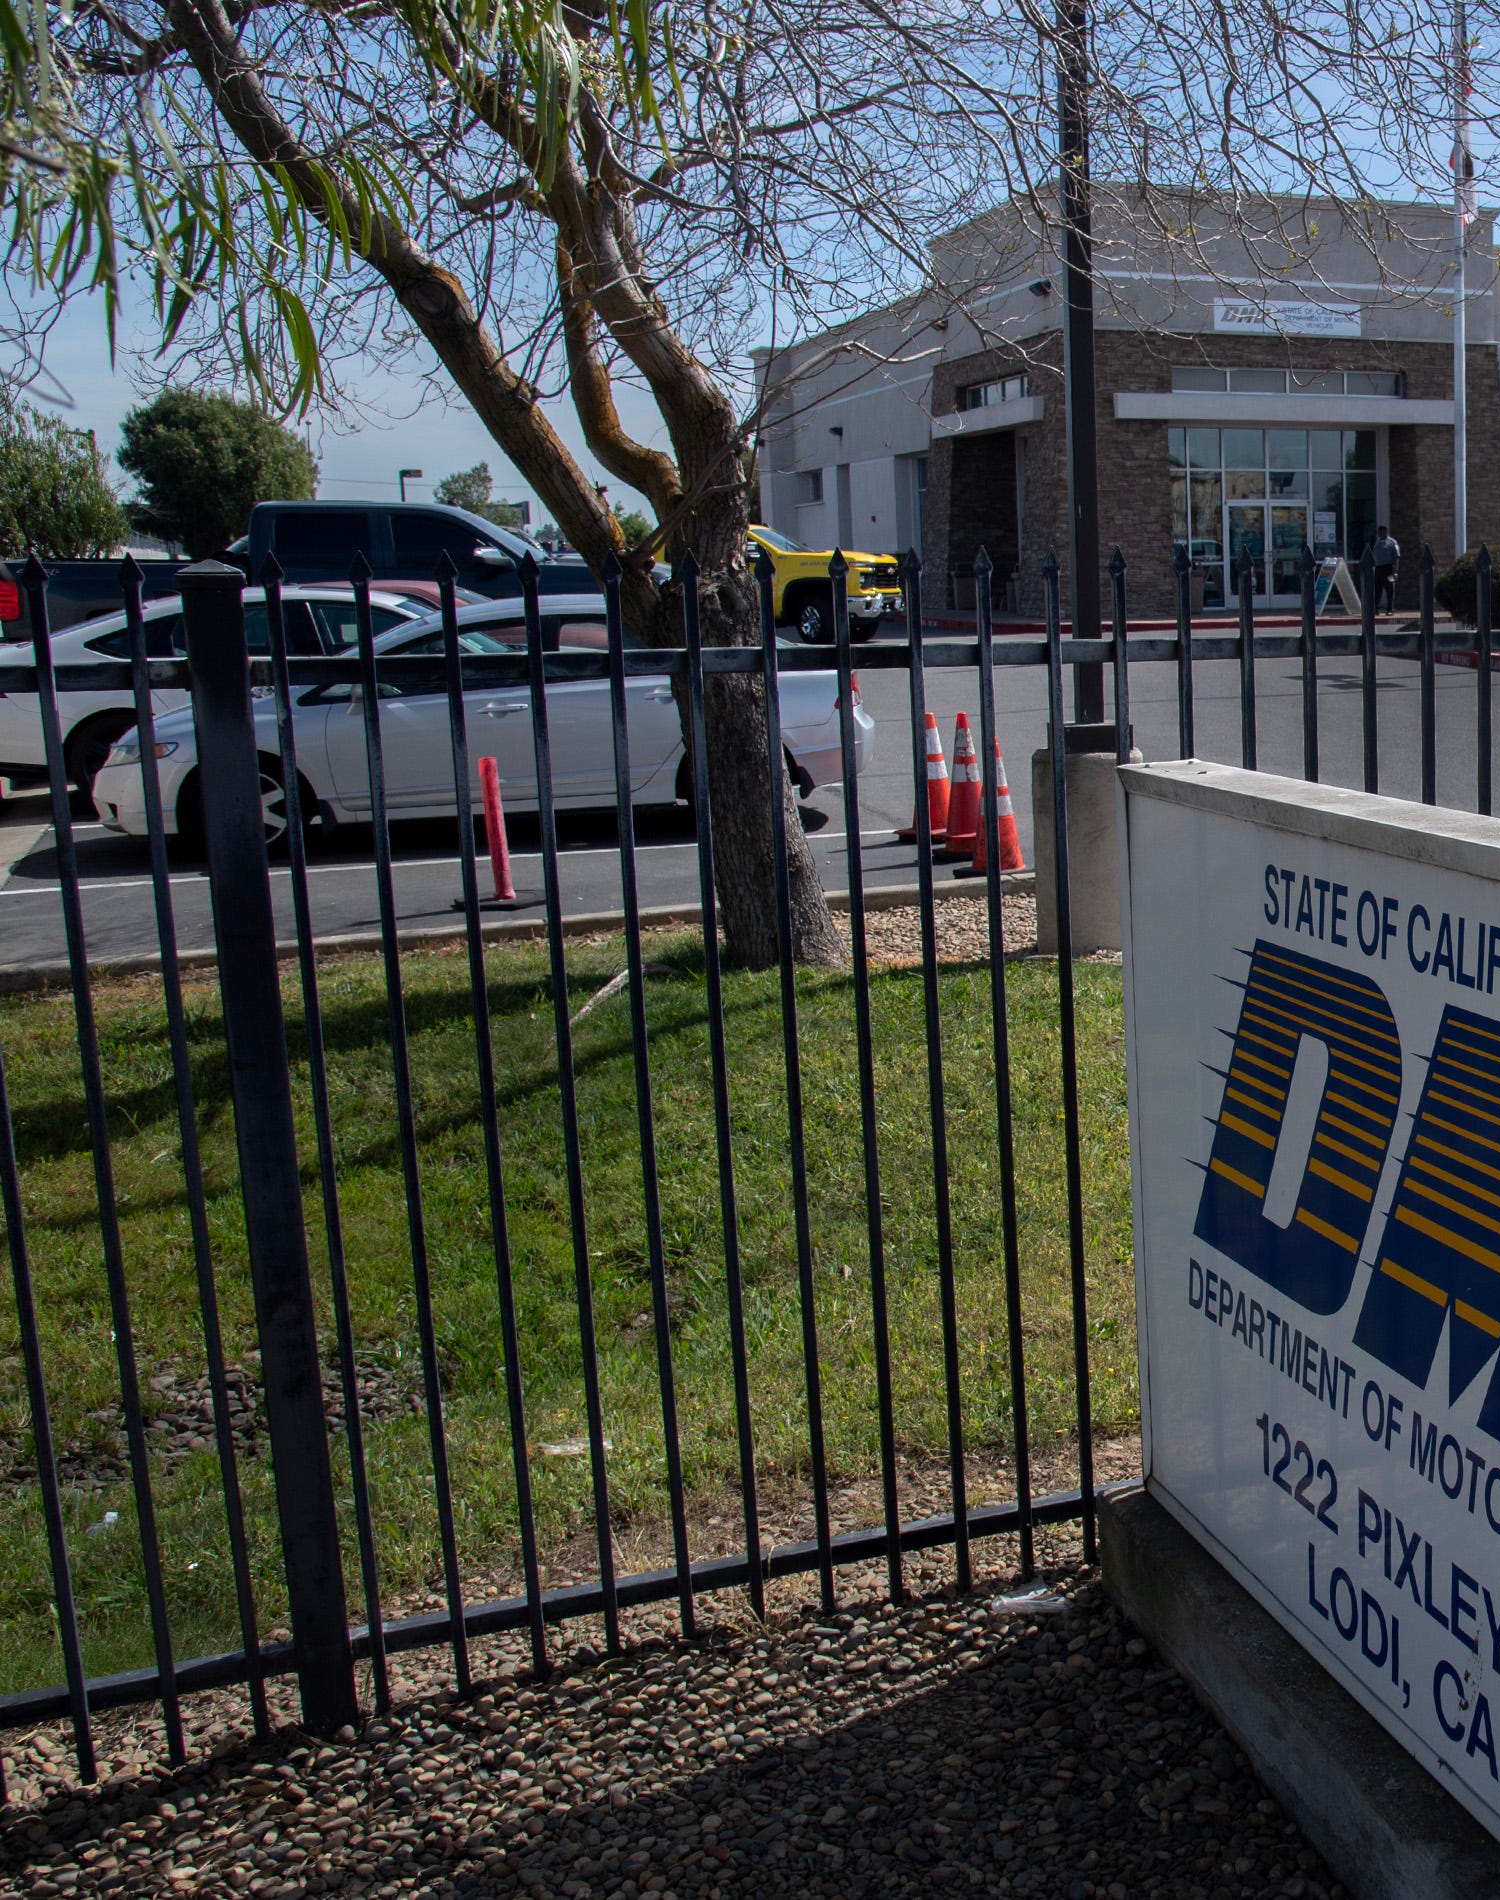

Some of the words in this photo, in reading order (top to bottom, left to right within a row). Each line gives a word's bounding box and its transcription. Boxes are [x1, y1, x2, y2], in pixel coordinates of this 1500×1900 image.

[1264, 864, 1348, 948] STATE
[1356, 890, 1399, 960] OF
[1189, 1257, 1357, 1420] DEPARTMENT
[1362, 1380, 1403, 1453] OF
[1256, 1412, 1338, 1536] 1222
[1308, 1541, 1410, 1710] LODI,
